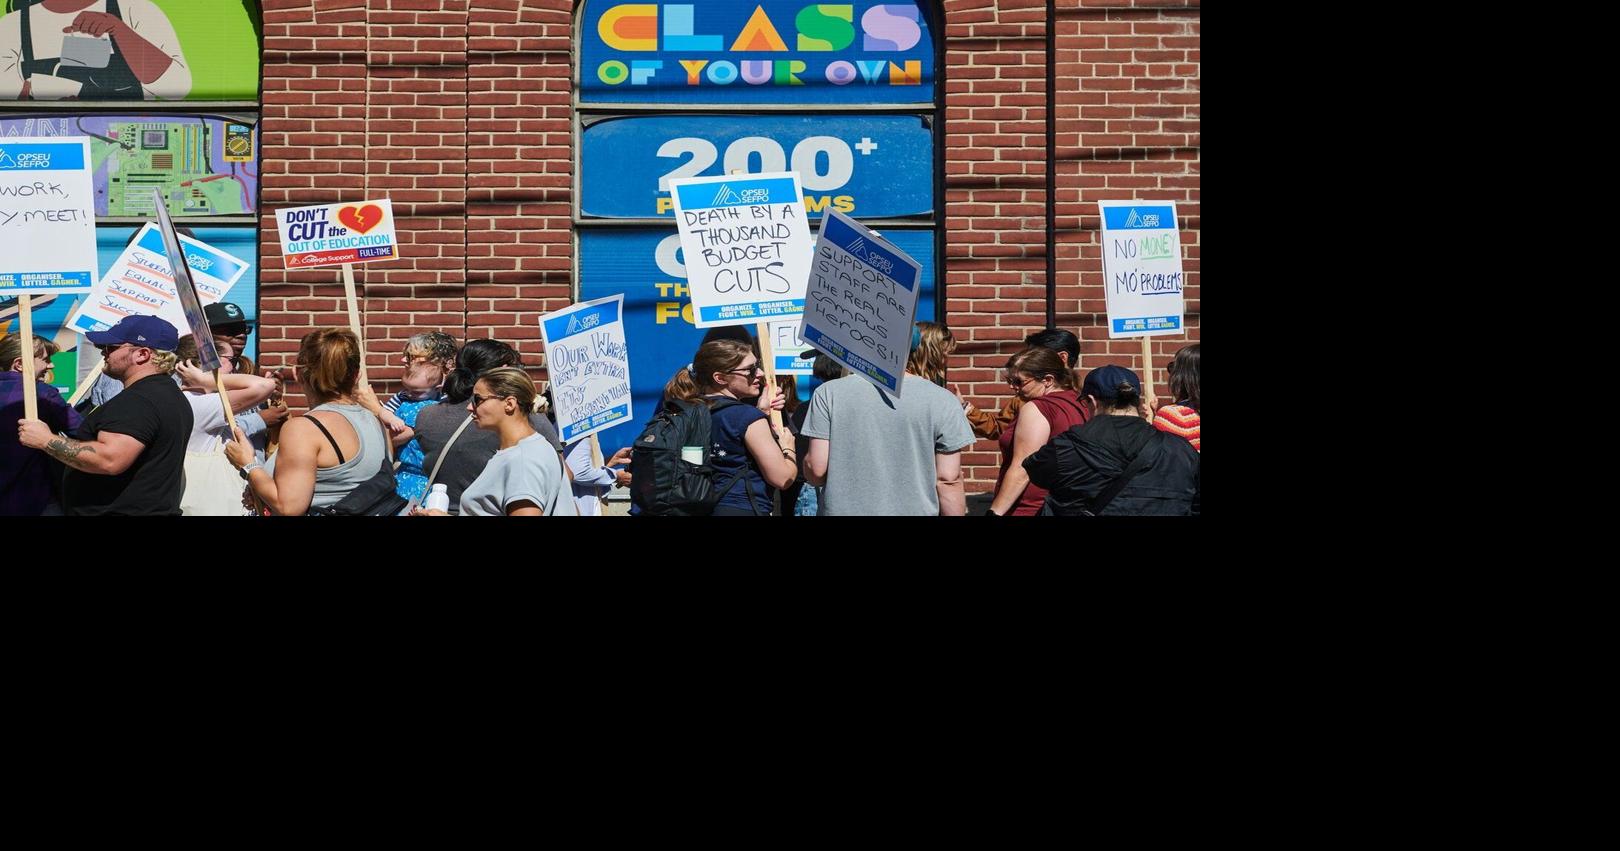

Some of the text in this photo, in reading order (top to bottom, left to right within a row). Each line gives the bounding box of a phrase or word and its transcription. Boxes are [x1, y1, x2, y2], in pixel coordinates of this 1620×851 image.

[597, 4, 921, 52] CLASS
[597, 60, 921, 85] OF YOUR OWN
[17, 153, 50, 161] OPSEU
[17, 160, 50, 168] SEFPO
[656, 136, 877, 192] 200+
[741, 188, 769, 196] OPSEU
[24, 209, 87, 226] MEET!
[286, 208, 329, 223] DON'T
[684, 207, 741, 226] DEATH
[750, 205, 772, 220] BY
[782, 204, 795, 219] A
[288, 221, 347, 241] CUT the
[690, 223, 791, 247] THOUSAND
[288, 234, 390, 253] OUT OF EDUCATION
[359, 247, 391, 257] FULL-TIME
[1115, 233, 1176, 259] NO MONEY
[301, 254, 354, 264] College Support
[701, 242, 786, 267] BUDGET
[714, 262, 790, 294] CUTS
[820, 246, 897, 295] SUPPORT
[819, 260, 906, 317] STAFF ARE
[1140, 272, 1182, 291] PROBLEMS
[721, 301, 794, 312] ORGANIZE. ORGANISER.
[815, 273, 885, 322] THE REAL
[718, 310, 739, 318] FIGHT.
[760, 307, 783, 315] LUTTER.
[553, 332, 627, 372] OUR WORK
